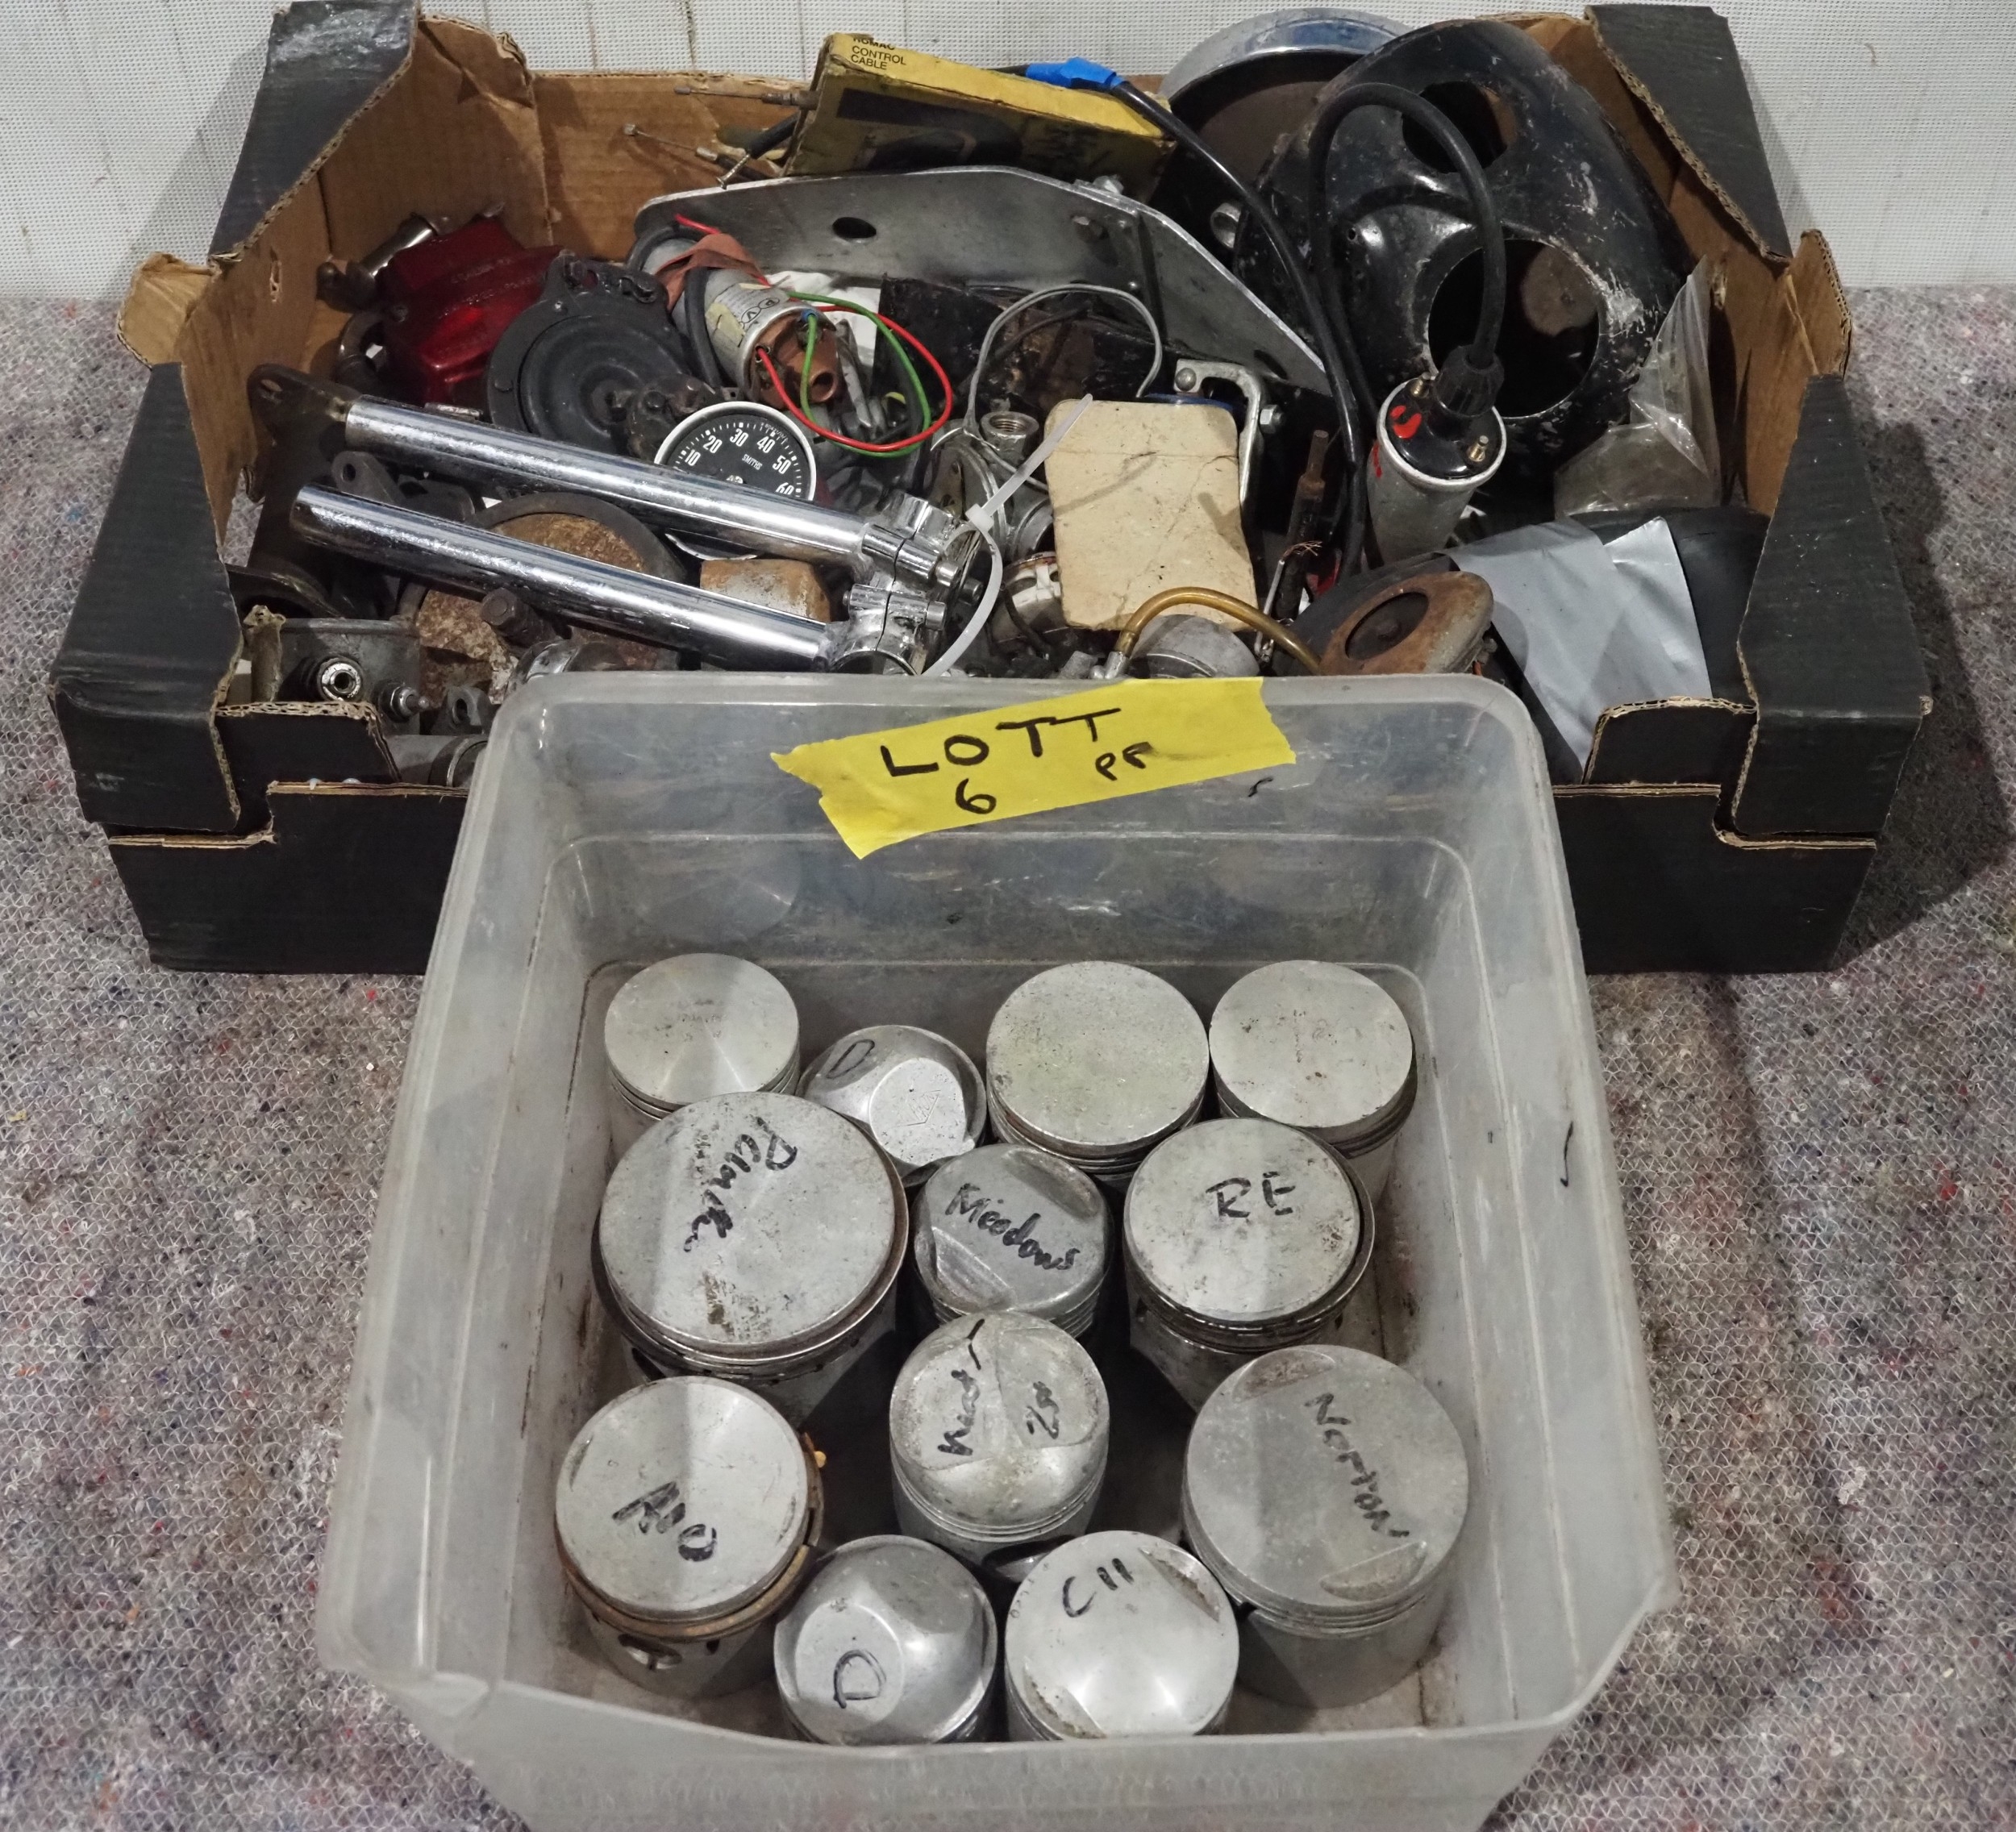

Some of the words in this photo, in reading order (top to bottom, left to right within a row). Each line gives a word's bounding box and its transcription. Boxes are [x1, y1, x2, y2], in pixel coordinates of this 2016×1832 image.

[851, 54, 888, 70] CABLE
[852, 45, 906, 65] CONTROL
[702, 435, 723, 454] 20
[729, 427, 749, 447] 30
[756, 435, 776, 453] 40
[684, 449, 702, 466] 10
[742, 453, 763, 470] SMITHS
[772, 455, 792, 474] 50
[880, 707, 1122, 777] LOTT
[955, 778, 997, 814] 6
[1206, 1171, 1296, 1218] RE
